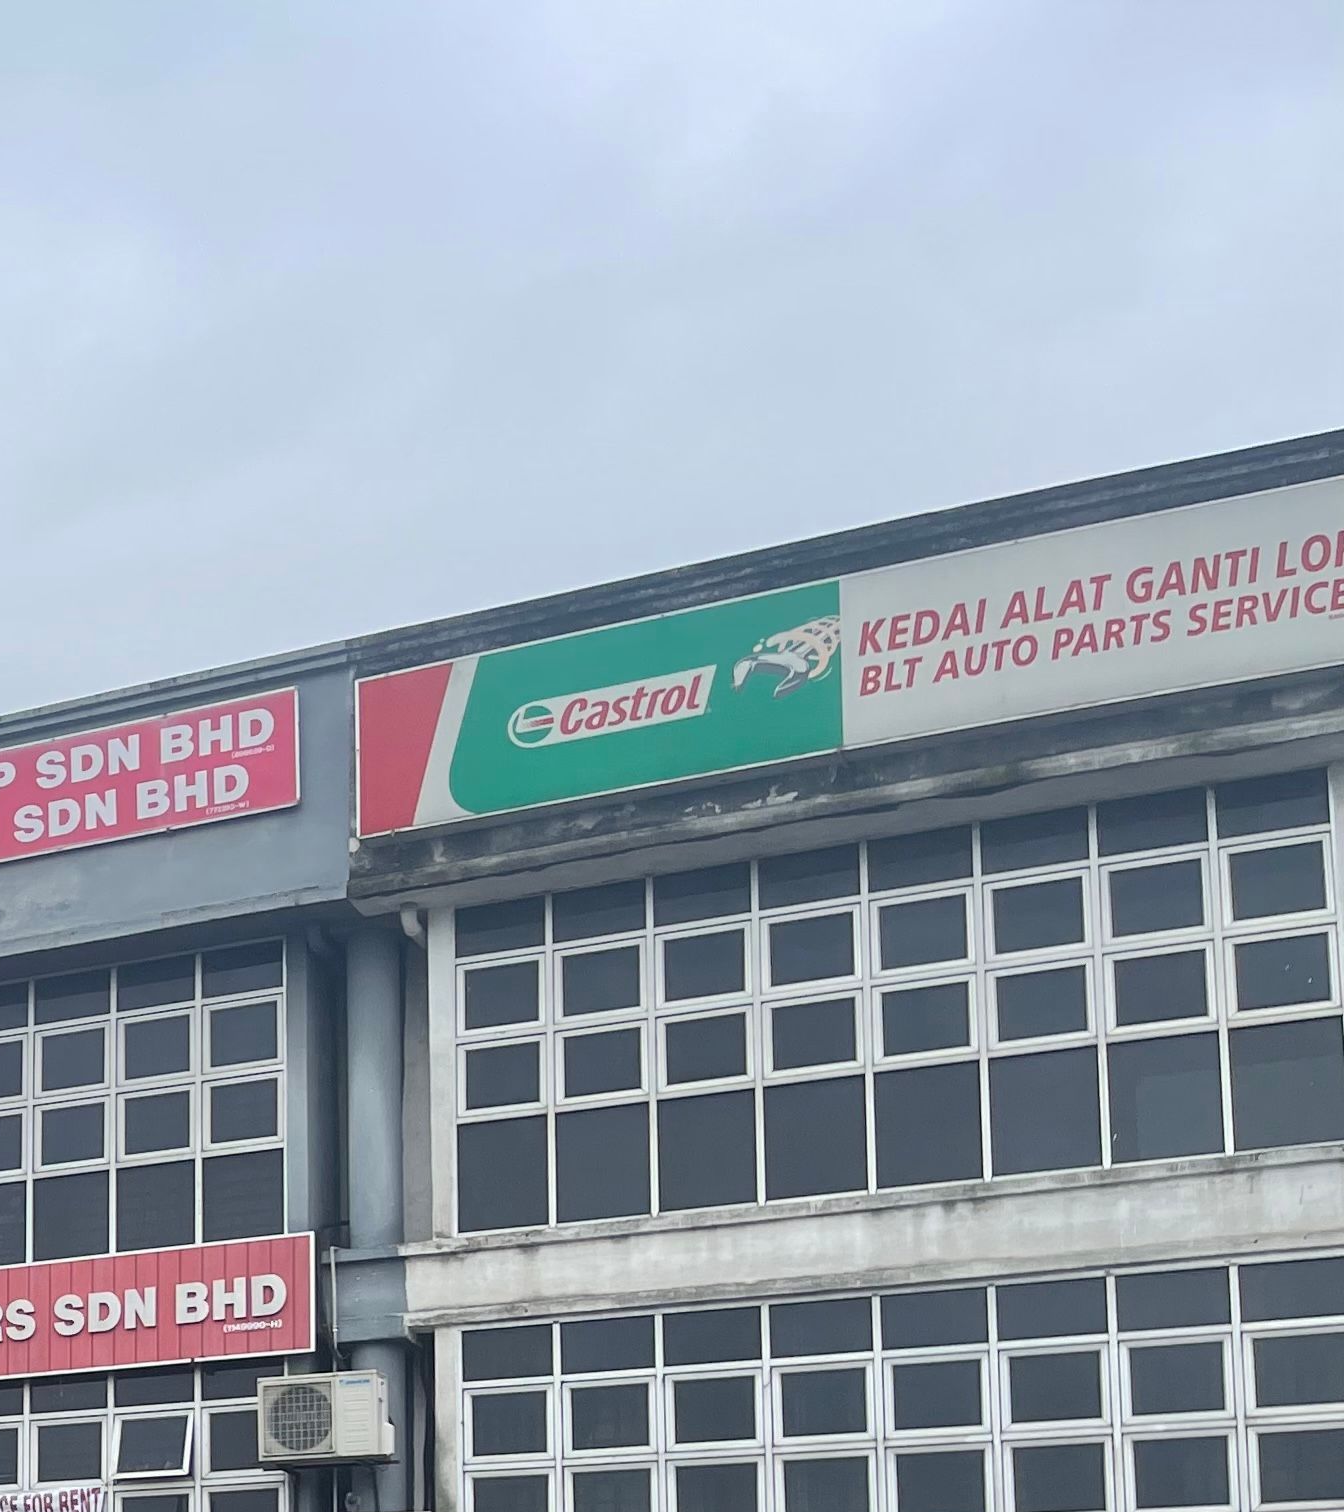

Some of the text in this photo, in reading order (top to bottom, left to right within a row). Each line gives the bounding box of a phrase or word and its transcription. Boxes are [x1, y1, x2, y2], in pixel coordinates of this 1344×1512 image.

[858, 596, 987, 657] KEDAI
[1000, 573, 1114, 630] ALAT
[1125, 546, 1260, 606] GANTI
[859, 653, 924, 697] BLT
[934, 634, 1039, 683] AUTO
[1052, 609, 1173, 661] PARTS
[559, 673, 702, 738] Castrol
[35, 737, 141, 790] SDN
[160, 707, 275, 766] BHD
[13, 789, 116, 843] SDN
[136, 764, 250, 820] BHD
[53, 1286, 158, 1339] SDN
[174, 1273, 288, 1326] BHD
